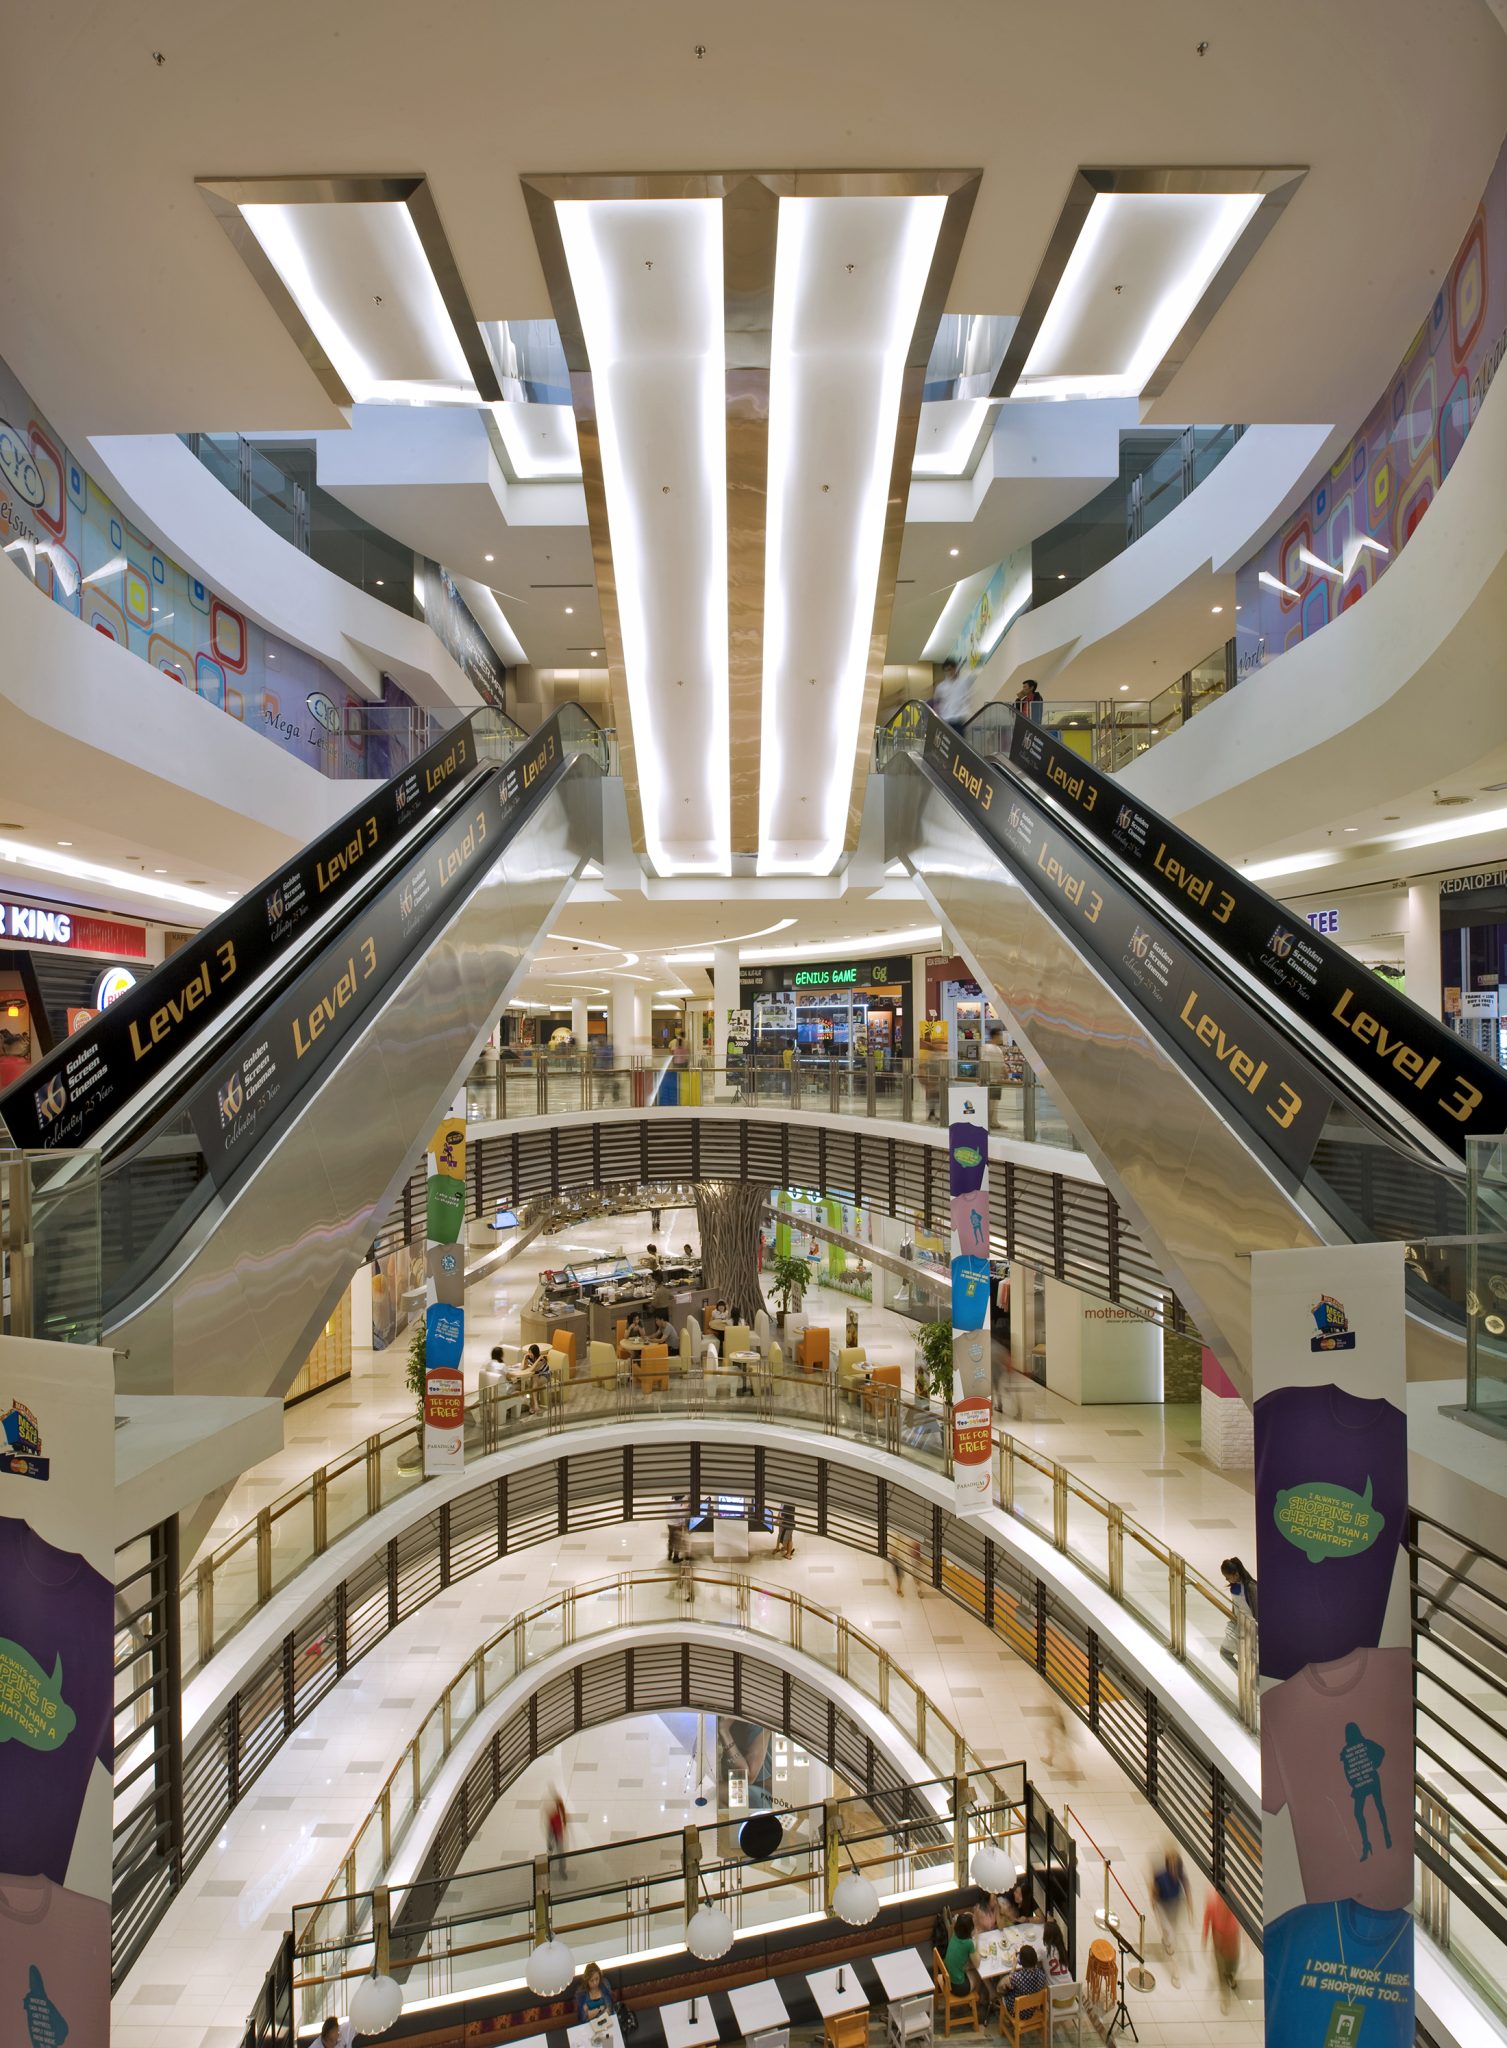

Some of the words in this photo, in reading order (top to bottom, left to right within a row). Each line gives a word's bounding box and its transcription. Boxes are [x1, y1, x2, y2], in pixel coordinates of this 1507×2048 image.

[265, 710, 300, 740] Mega
[426, 748, 456, 793] Level
[458, 740, 466, 764] 3
[523, 744, 546, 789] Level
[548, 736, 554, 760] 3
[952, 754, 982, 800] Level
[982, 784, 994, 811] 3
[1046, 756, 1084, 800] Level
[1083, 786, 1098, 812] 3
[316, 828, 364, 894] Level
[366, 816, 378, 848] 3
[438, 824, 475, 888] Level
[476, 811, 486, 843] 3
[1038, 840, 1086, 908] Level
[1084, 892, 1103, 924] 3
[1154, 842, 1214, 907] Level
[1212, 890, 1236, 924] 3
[12, 904, 71, 943] KING
[1148, 950, 1169, 974] Screen
[1152, 942, 1174, 966] Golden
[1292, 949, 1318, 972] Screen
[1298, 940, 1324, 964] Golden
[796, 971, 829, 985] GENIUS
[832, 968, 857, 983] GAME
[872, 966, 887, 982] Gg
[1144, 959, 1168, 986] Cinemas
[1260, 953, 1287, 986] Celebrating
[1286, 978, 1296, 988] 25
[1296, 983, 1310, 1000] Years
[1286, 957, 1318, 986] Cinemas
[129, 961, 212, 1062] Level
[216, 940, 238, 984] 3
[292, 958, 357, 1060] Level
[361, 936, 377, 980] 3
[66, 1044, 98, 1074] Golden
[242, 1040, 268, 1073] Golden
[1180, 990, 1269, 1095] Level
[1266, 1082, 1303, 1130] 3
[1331, 988, 1442, 1091] Level
[1438, 1076, 1484, 1122] 3
[68, 1057, 100, 1088] Screen
[70, 1065, 108, 1102] Cinemas
[244, 1055, 270, 1087] Screen
[246, 1062, 276, 1100] Cinemas
[44, 1111, 84, 1149] Celebrating
[85, 1100, 96, 1115] 25
[98, 1084, 114, 1106] Years
[224, 1109, 256, 1150] Celebrating
[258, 1096, 266, 1112] 25
[266, 1082, 281, 1101] Years
[1327, 1313, 1344, 1325] SALE
[430, 1408, 458, 1418] FREE
[445, 1399, 460, 1407] FOR
[18, 1414, 37, 1433] MEGA
[19, 1425, 37, 1446] SALE
[958, 1432, 972, 1441] TEE
[973, 1430, 988, 1439] FOR
[959, 1441, 986, 1453] FREE
[1289, 1496, 1352, 1523] SHOPPING
[1355, 1513, 1370, 1527] IS
[1315, 1494, 1340, 1506] ALWAYS
[1280, 1508, 1335, 1532] CHEAPER
[1338, 1525, 1360, 1538] THAN
[1362, 1532, 1368, 1542] A
[1290, 1525, 1354, 1548] PSYCHIATRIST
[24, 1703, 47, 1731] THAN
[48, 1728, 56, 1740] A
[41, 1696, 57, 1718] IS
[1306, 1959, 1312, 1970] I
[1314, 1960, 1347, 1976] DON'T
[1350, 1966, 1381, 1982] WORK
[1301, 1976, 1318, 1988] I'M
[1320, 1979, 1375, 1998] SHOPPING
[1378, 1989, 1408, 2002] TOO...
